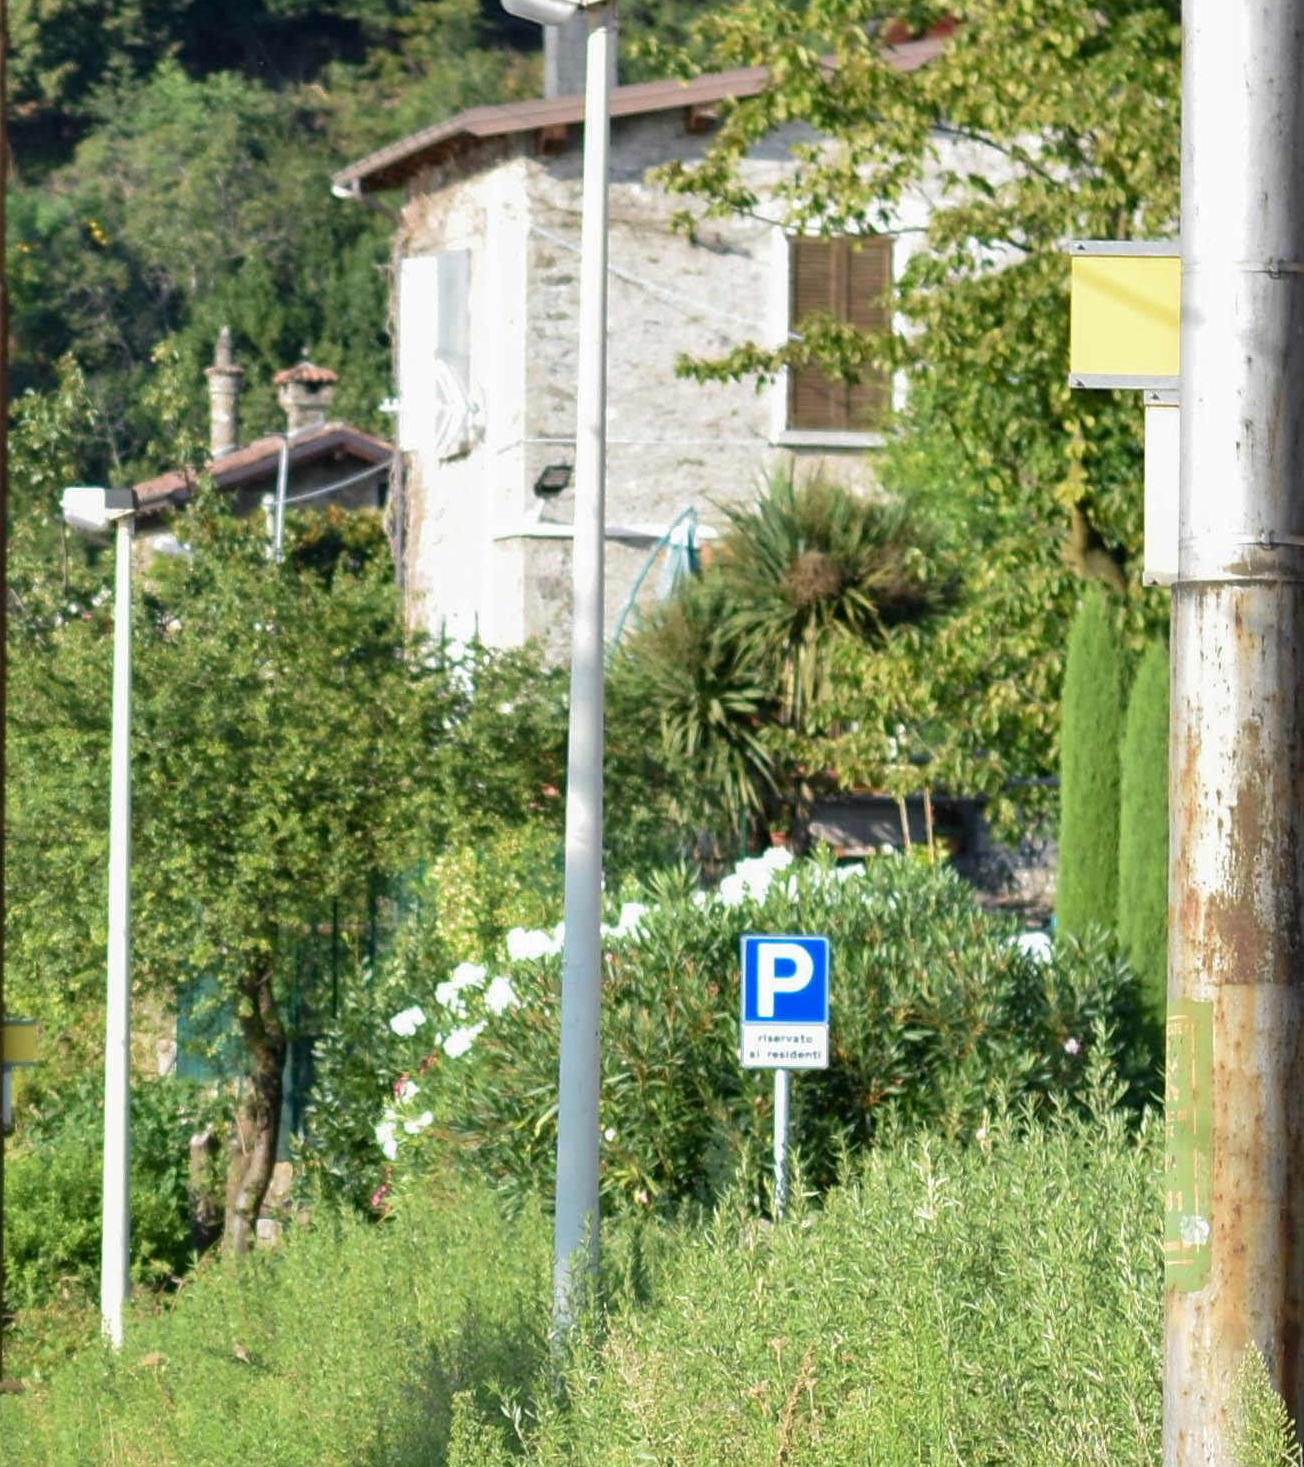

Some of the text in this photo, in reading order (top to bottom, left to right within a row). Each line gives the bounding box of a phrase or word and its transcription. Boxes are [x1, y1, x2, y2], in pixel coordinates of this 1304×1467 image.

[757, 943, 814, 1018] P
[758, 1034, 813, 1044] riservato
[767, 1049, 822, 1059] residenti
